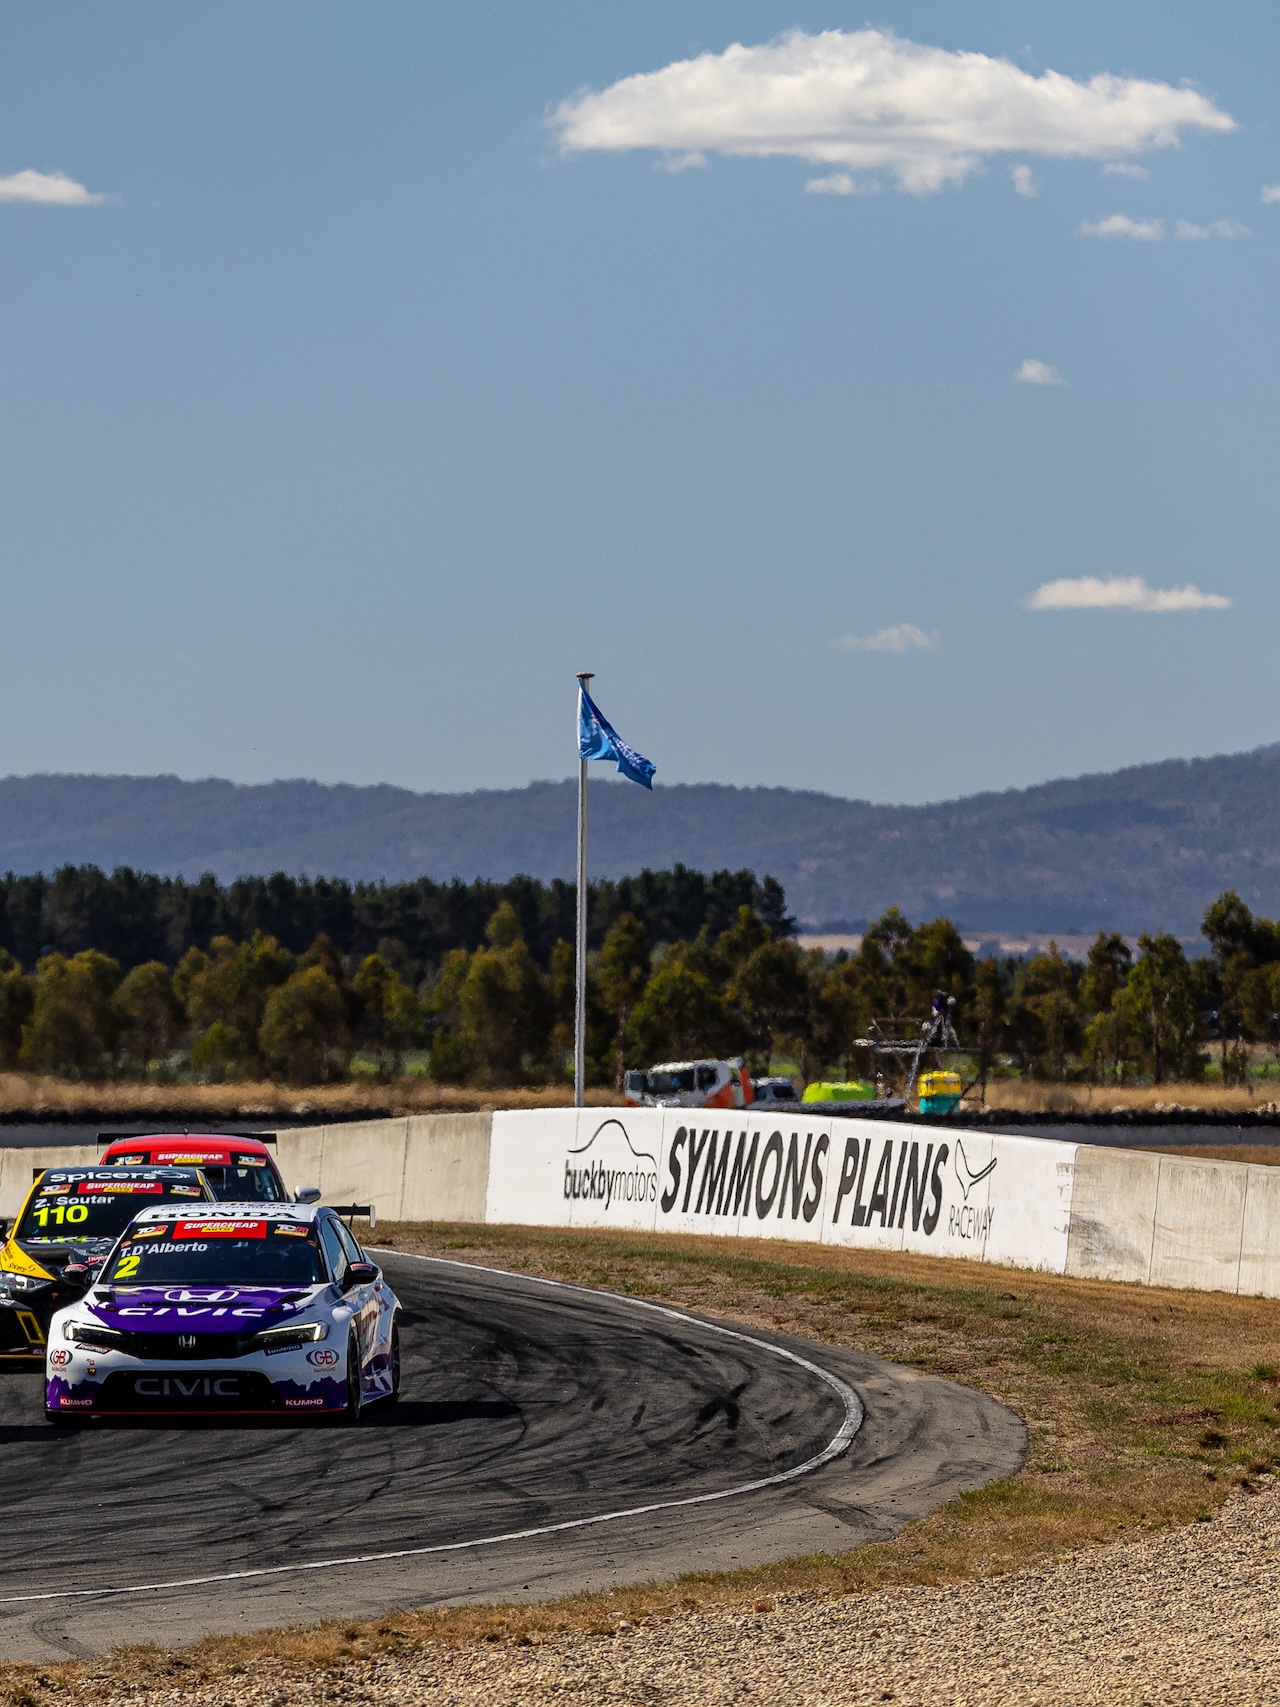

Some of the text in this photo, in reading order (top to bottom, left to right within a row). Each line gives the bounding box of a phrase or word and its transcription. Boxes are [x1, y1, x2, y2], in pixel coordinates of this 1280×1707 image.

[50, 1171, 158, 1183] Spicers
[661, 1126, 950, 1236] SYMMONS PLAINS
[35, 1195, 115, 1209] Z. Soutar
[33, 1205, 89, 1227] 110
[150, 1211, 300, 1219] HONDA
[948, 1204, 995, 1241] RACEWAY
[183, 1222, 259, 1230] SUPERCHEAP
[120, 1242, 208, 1258] T.D'Alberto
[114, 1256, 141, 1279] 2
[118, 1307, 266, 1317] CIVIC
[53, 1350, 67, 1365] GB
[314, 1350, 334, 1365] GB
[134, 1378, 241, 1396] CIVIC
[60, 1398, 93, 1406] KUMHO
[285, 1398, 324, 1406] KUMHO
